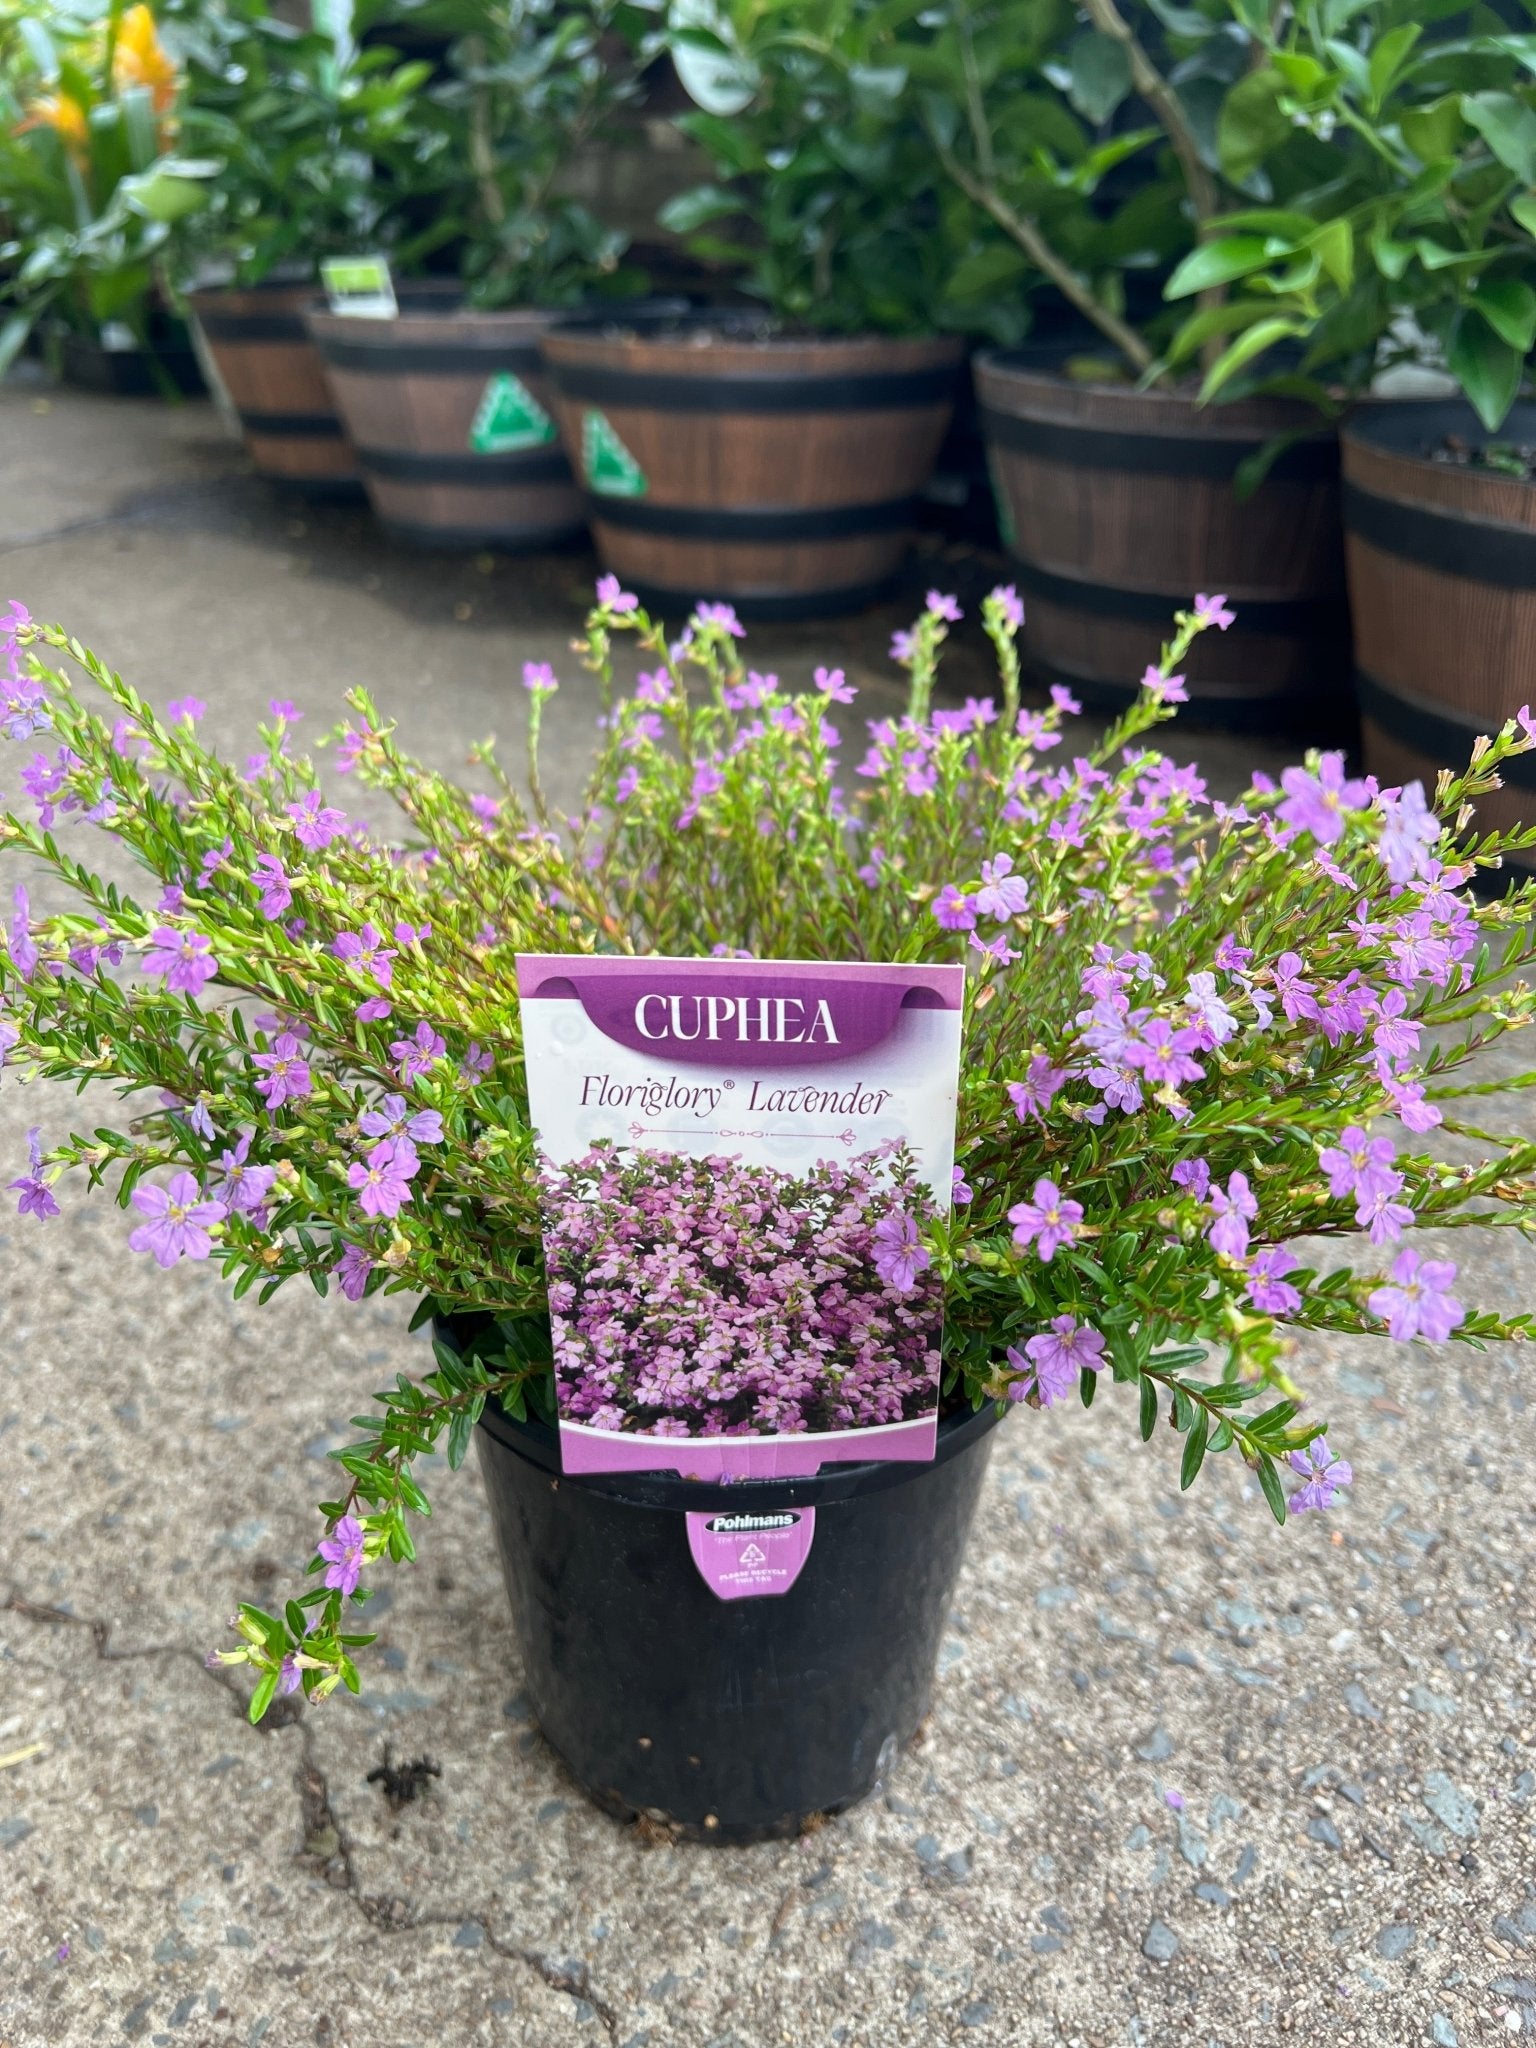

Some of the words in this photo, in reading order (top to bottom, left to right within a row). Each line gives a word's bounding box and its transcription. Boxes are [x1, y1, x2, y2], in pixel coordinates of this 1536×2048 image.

[634, 994, 841, 1044] CUPHEA
[746, 1080, 893, 1116] Lavender
[713, 1514, 794, 1531] Pohlmans
[719, 1571, 749, 1581] PLEASE
